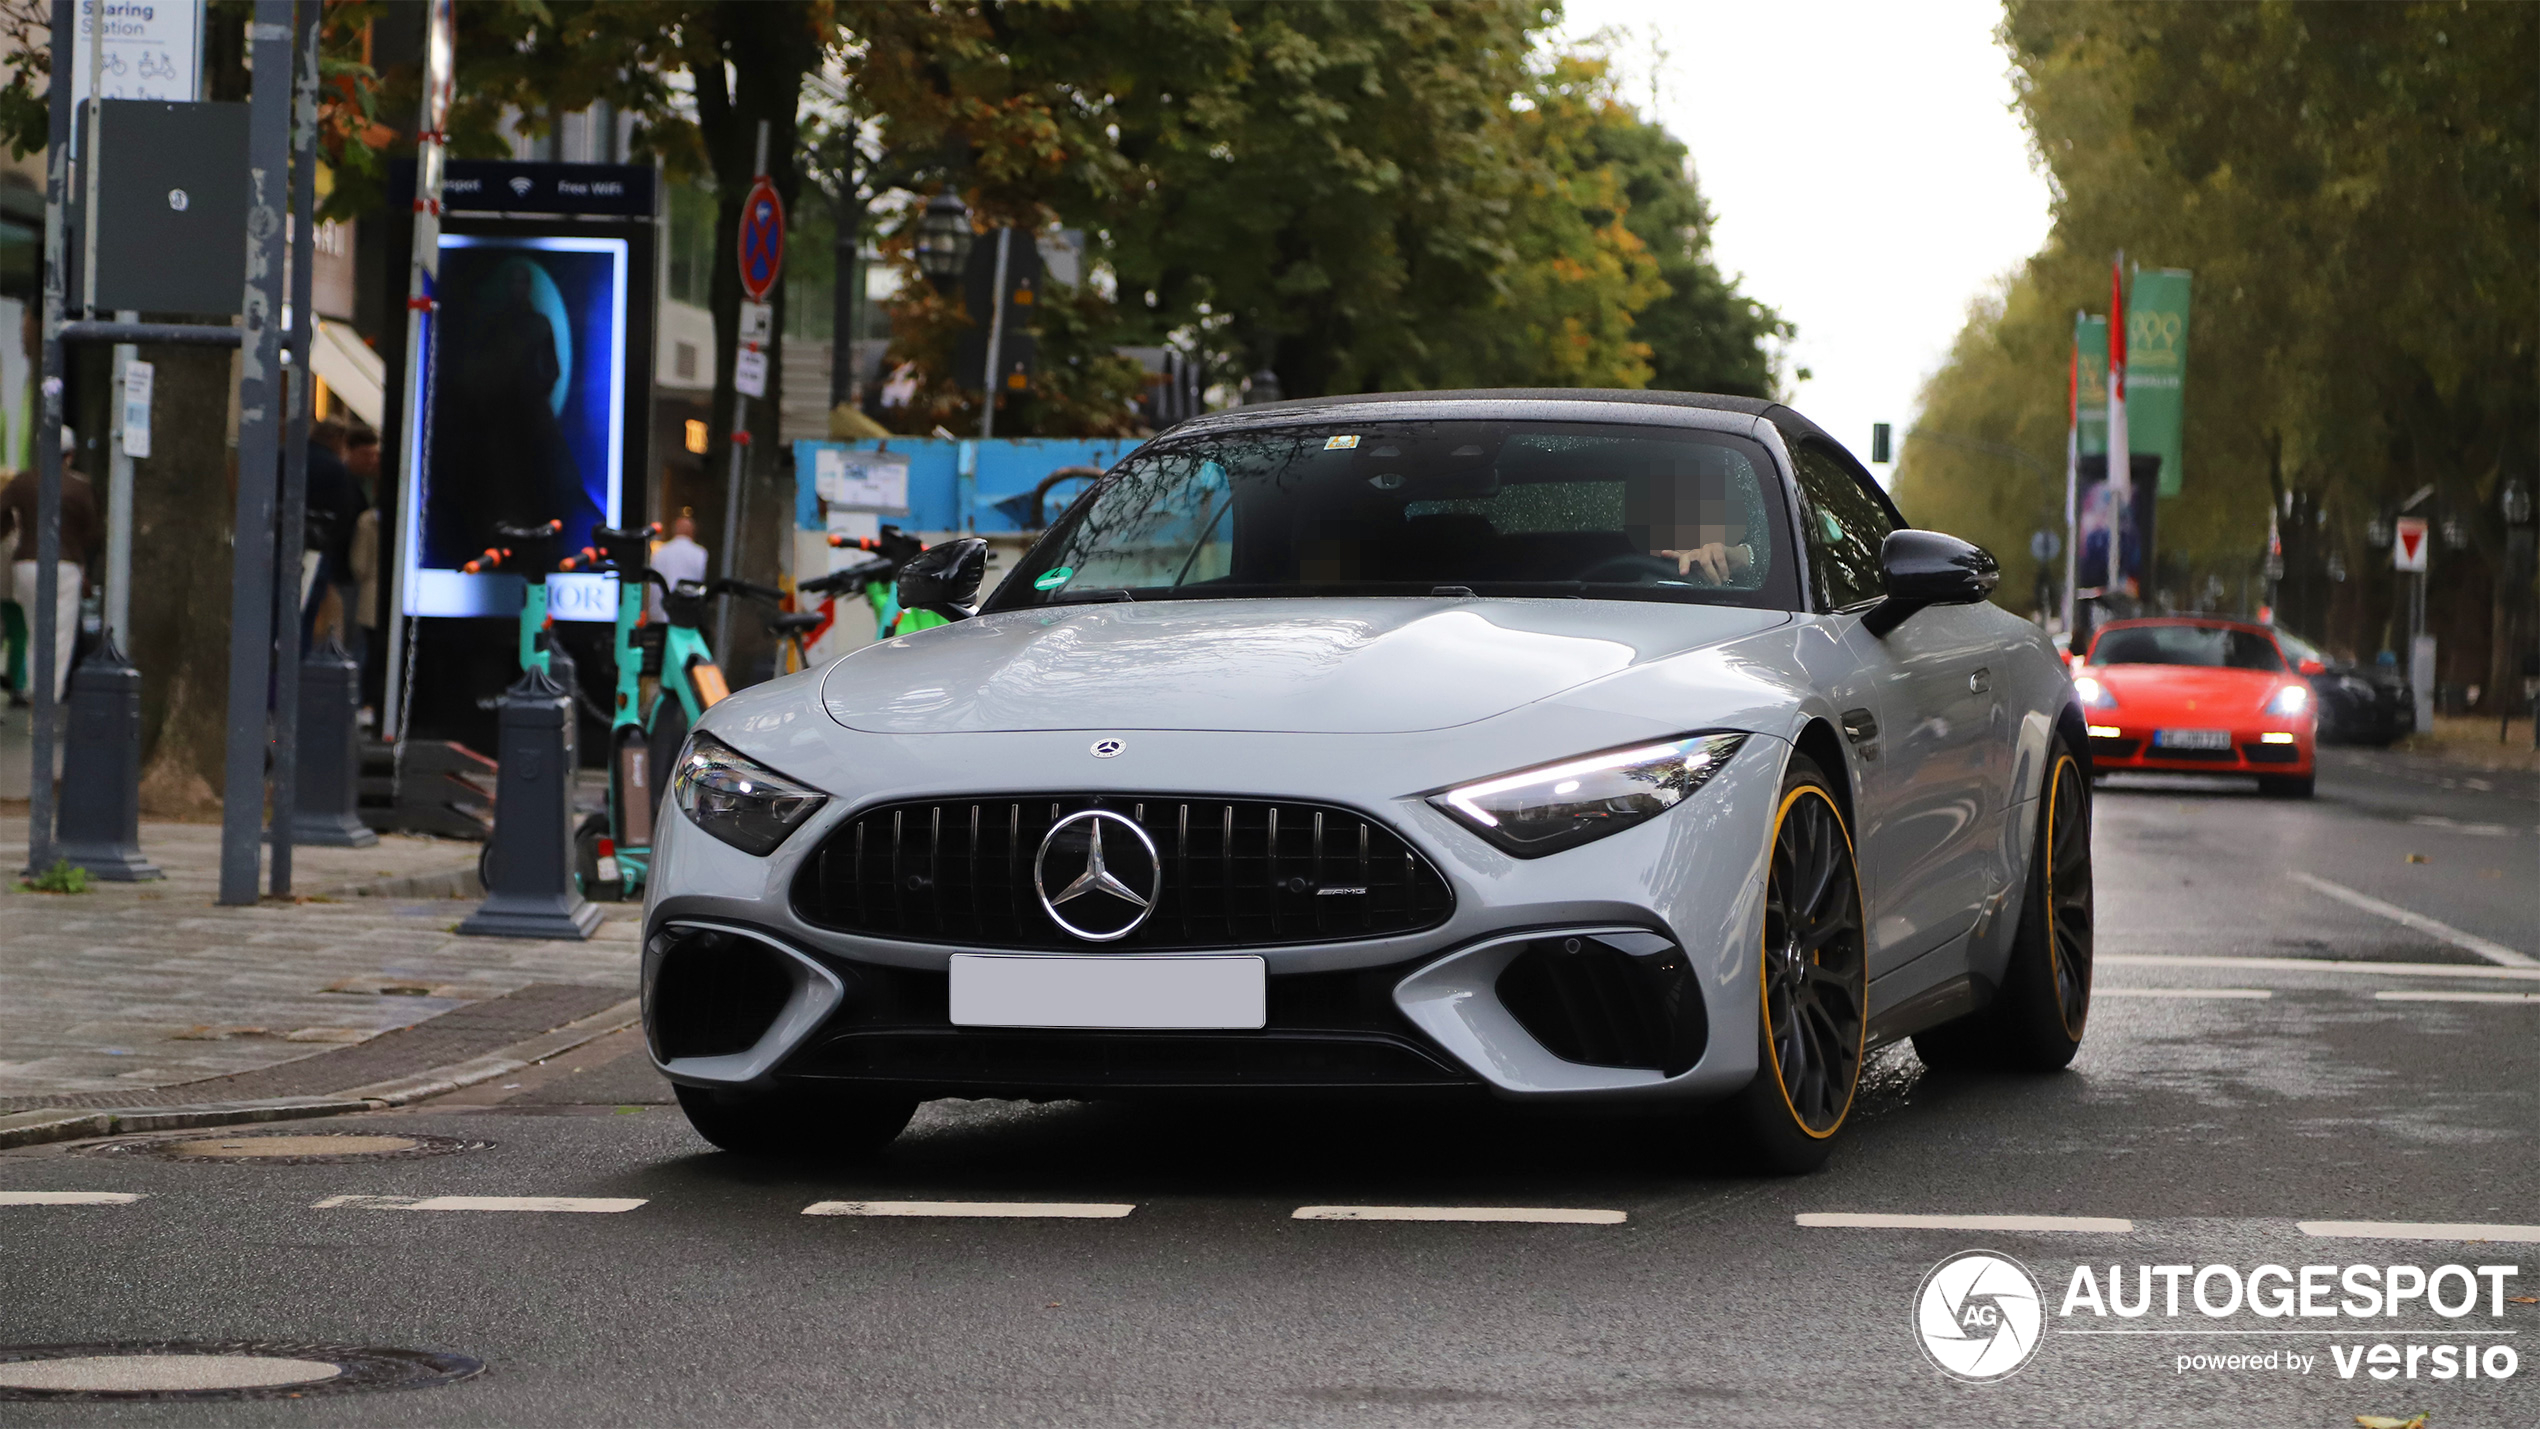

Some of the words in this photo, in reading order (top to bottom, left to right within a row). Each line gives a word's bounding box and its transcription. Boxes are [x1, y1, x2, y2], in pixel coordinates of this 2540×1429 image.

[82, 0, 153, 20] Saring
[81, 18, 144, 35] Sation
[557, 180, 588, 195] Free
[1050, 567, 1061, 578] 4
[547, 585, 604, 611] IOR
[1331, 888, 1367, 896] AMG
